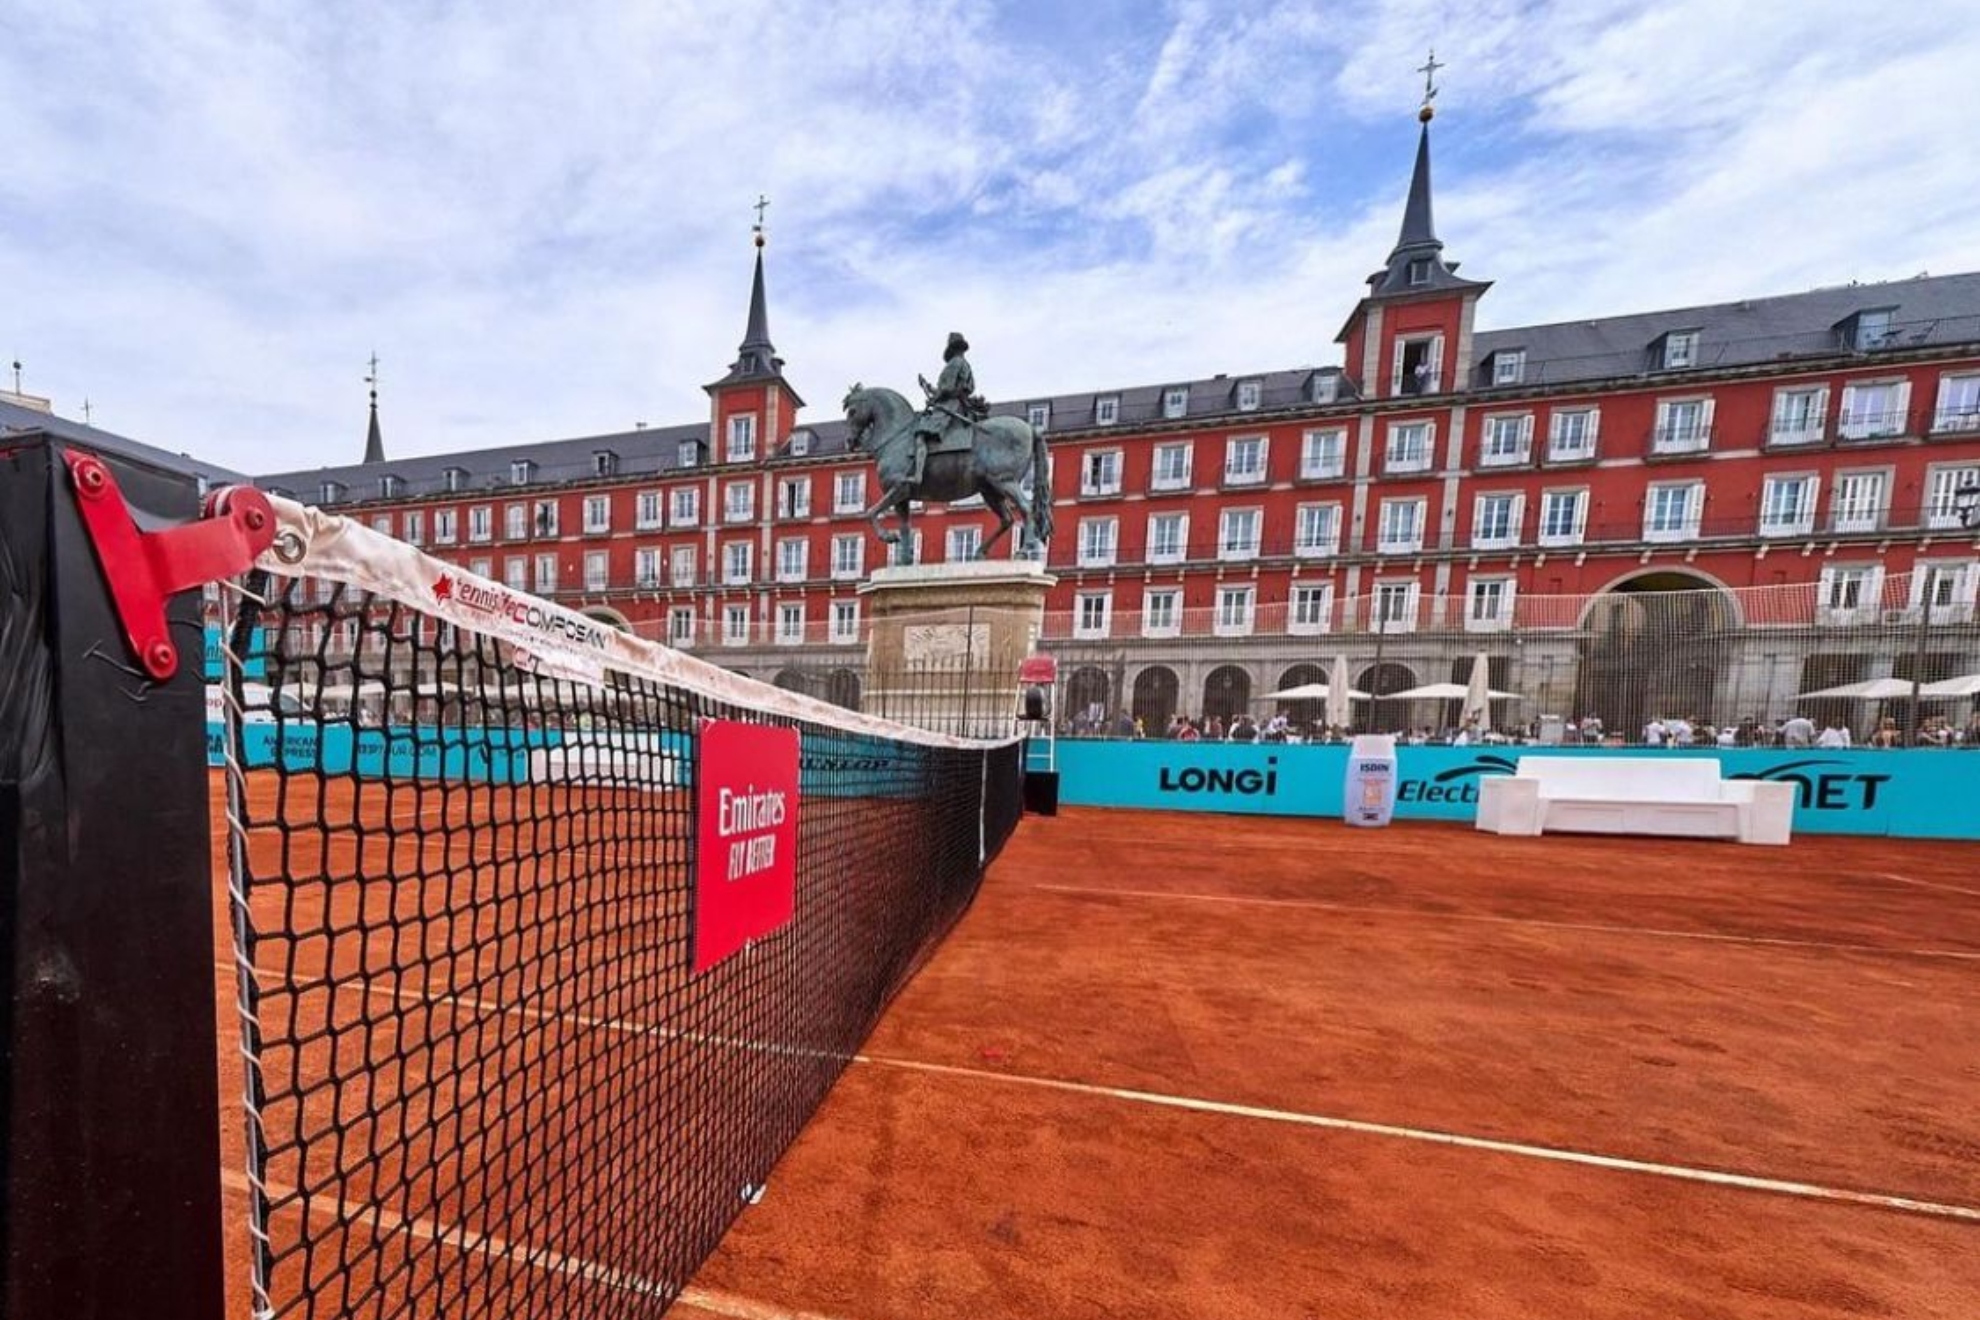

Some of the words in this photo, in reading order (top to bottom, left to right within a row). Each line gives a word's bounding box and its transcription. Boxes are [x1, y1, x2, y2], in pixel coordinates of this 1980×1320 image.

[264, 735, 317, 746] AMRICAN
[1360, 763, 1390, 773] ISDIN
[719, 783, 786, 837] Emirates
